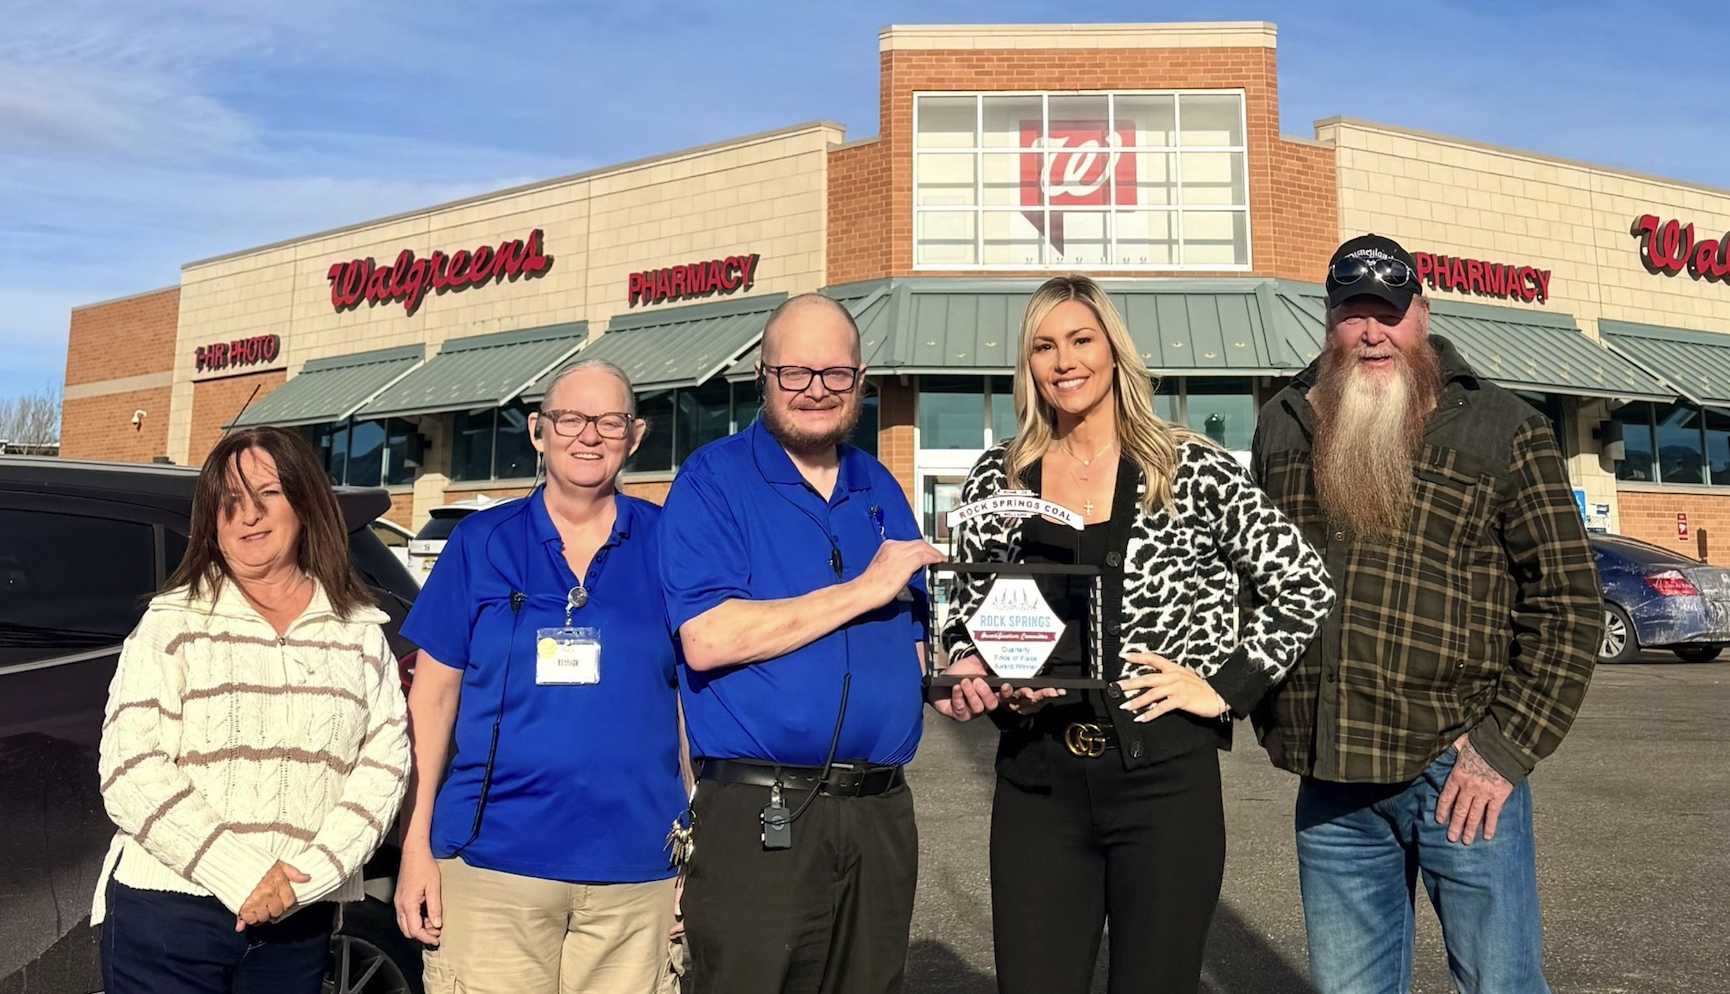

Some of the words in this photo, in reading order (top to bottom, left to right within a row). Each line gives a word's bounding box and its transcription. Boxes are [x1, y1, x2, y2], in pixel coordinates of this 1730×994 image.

[326, 229, 550, 313] Walgreens
[628, 254, 757, 306] PHARMACY
[1415, 252, 1552, 301] PHARMACY
[194, 343, 227, 371] 1-HR
[229, 334, 278, 366] PHOTO
[958, 503, 988, 519] ROCK
[992, 499, 1040, 510] SPRINGS
[1044, 505, 1072, 522] COAL
[980, 615, 1006, 627] ROCK
[1009, 615, 1051, 628] SPRINGS
